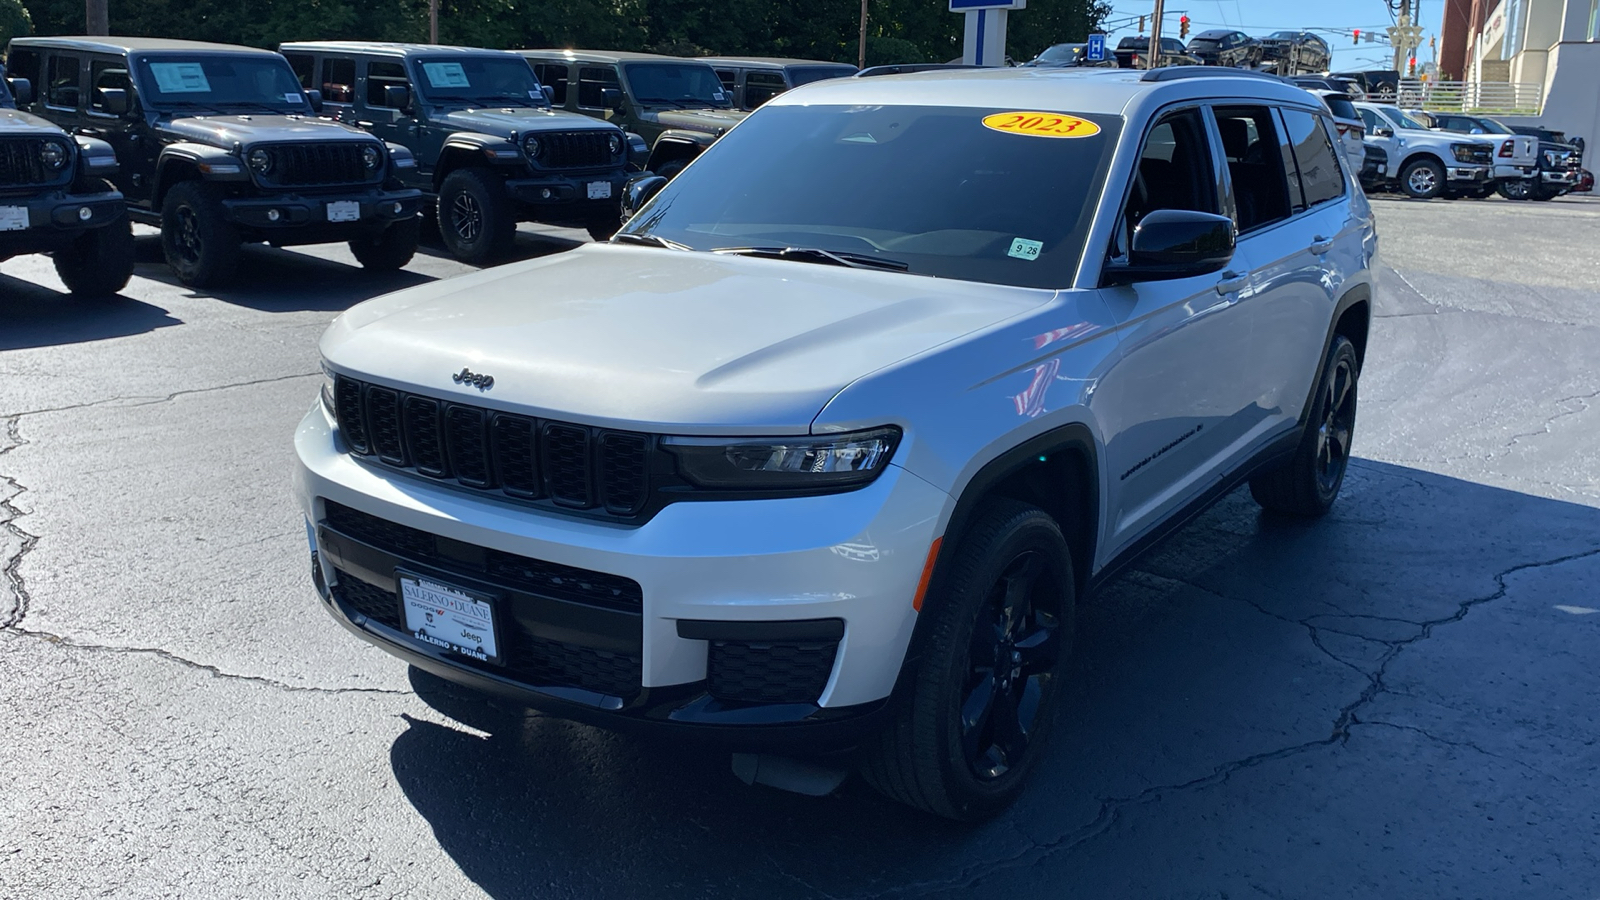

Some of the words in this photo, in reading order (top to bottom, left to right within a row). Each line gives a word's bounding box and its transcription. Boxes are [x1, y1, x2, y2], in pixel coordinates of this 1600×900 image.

[1091, 40, 1101, 53] H
[997, 115, 1082, 133] 2023
[1016, 244, 1023, 253] 9
[1027, 246, 1038, 255] 28
[452, 367, 495, 391] Jeep
[404, 585, 449, 607] SALERNO
[454, 600, 490, 620] DUANE
[460, 629, 482, 644] Jeep
[414, 632, 450, 649] SALERNO
[460, 646, 488, 661] DUANE
